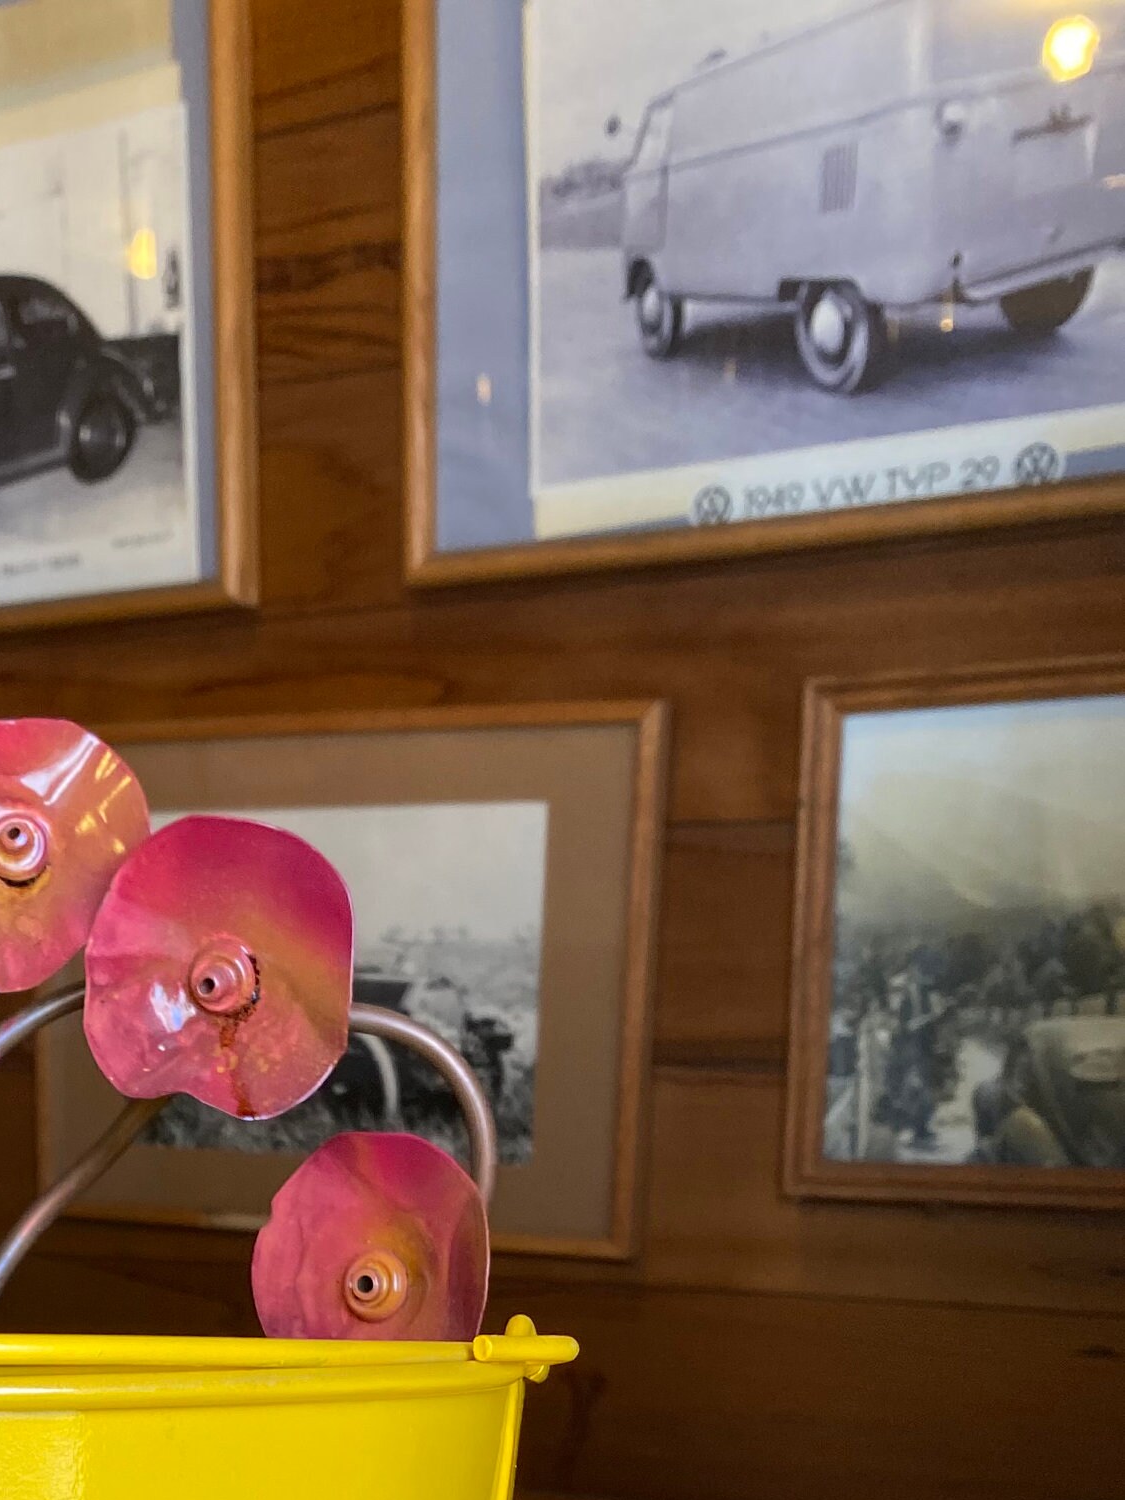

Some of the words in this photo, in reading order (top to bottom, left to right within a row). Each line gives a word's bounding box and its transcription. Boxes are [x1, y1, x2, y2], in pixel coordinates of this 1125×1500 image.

[743, 481, 803, 517] 1949
[811, 474, 876, 508] VW
[882, 461, 950, 498] TYP
[959, 456, 1000, 489] 29
